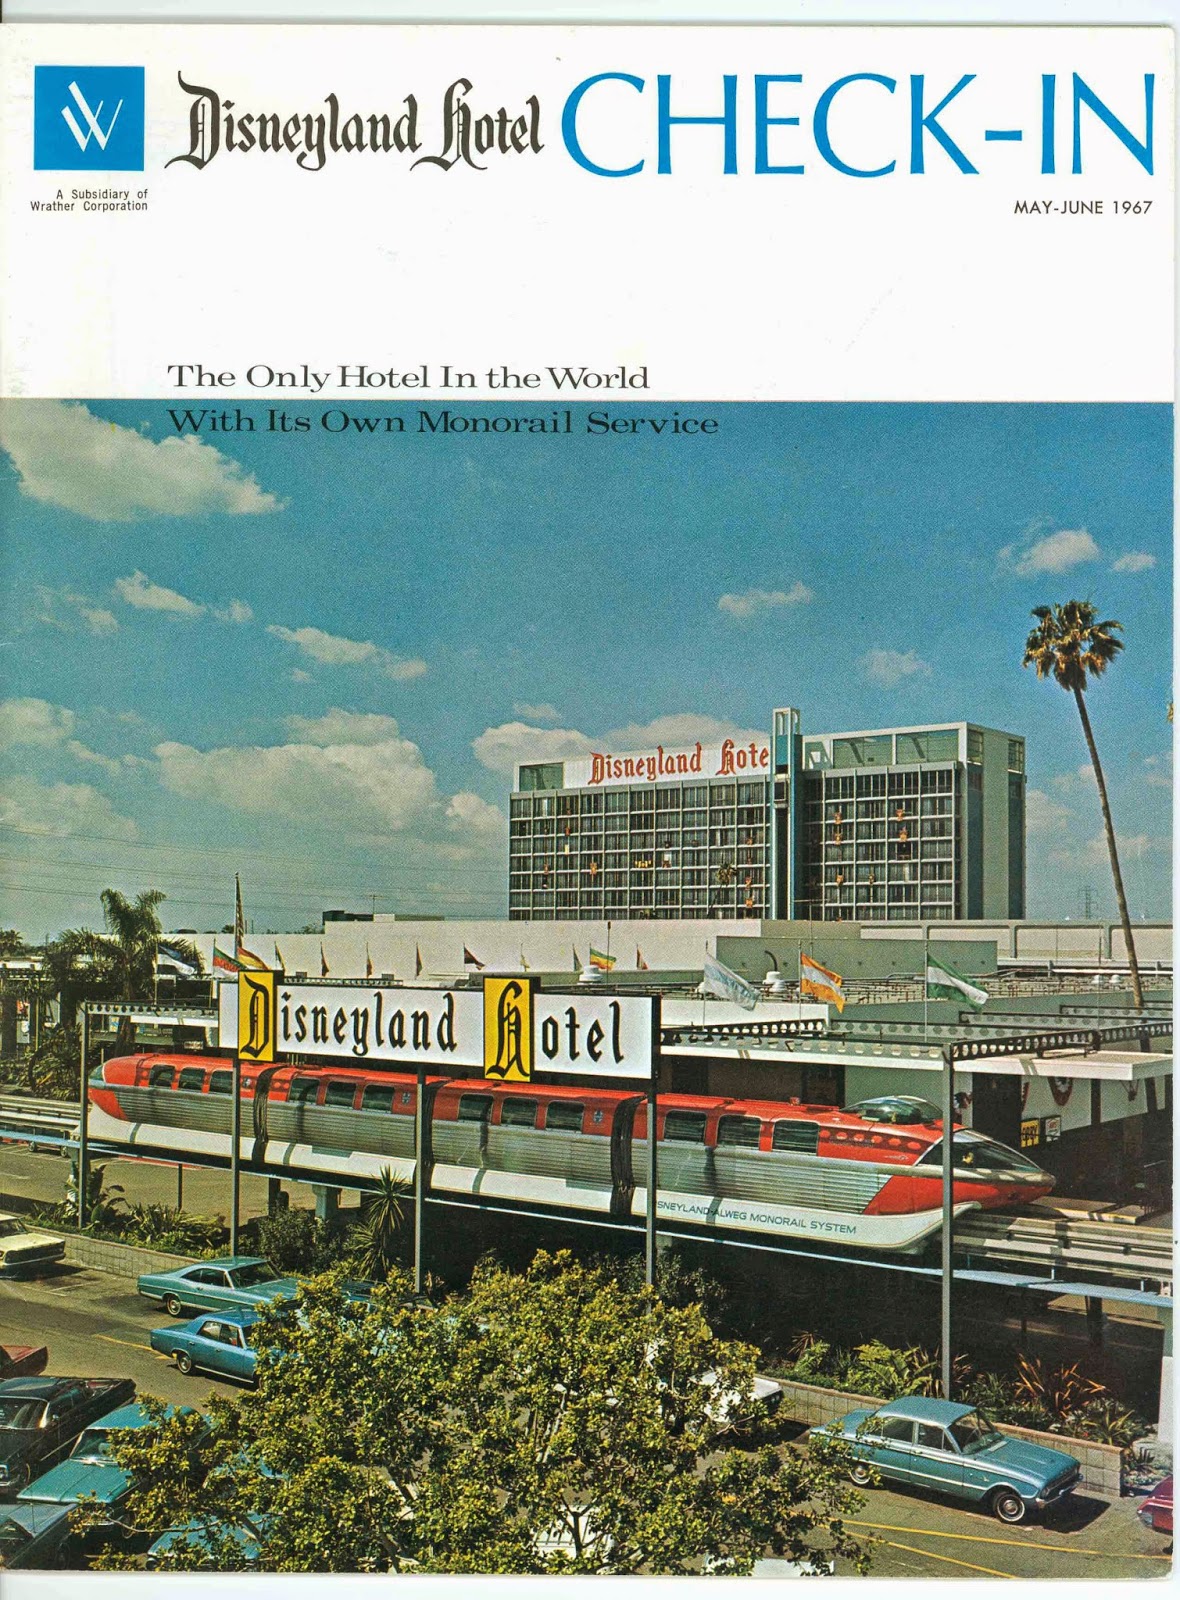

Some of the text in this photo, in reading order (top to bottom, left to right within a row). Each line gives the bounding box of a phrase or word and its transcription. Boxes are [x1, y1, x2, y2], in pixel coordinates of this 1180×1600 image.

[164, 70, 1155, 178] Disneyland Hotel CHECK-IN
[30, 200, 148, 213] Wrather Corporation
[56, 188, 148, 201] A Subsidiary of
[1013, 200, 1153, 215] MAY-JUNE 1967
[167, 364, 650, 393] The Only Hotel In the World
[166, 408, 719, 435] With Its Own Monorail Service
[587, 738, 770, 785] Disneyland Hote
[240, 972, 625, 1079] Disneyland Hotel
[749, 1213, 807, 1229] MONORAIL
[810, 1220, 857, 1235] SYSTEM
